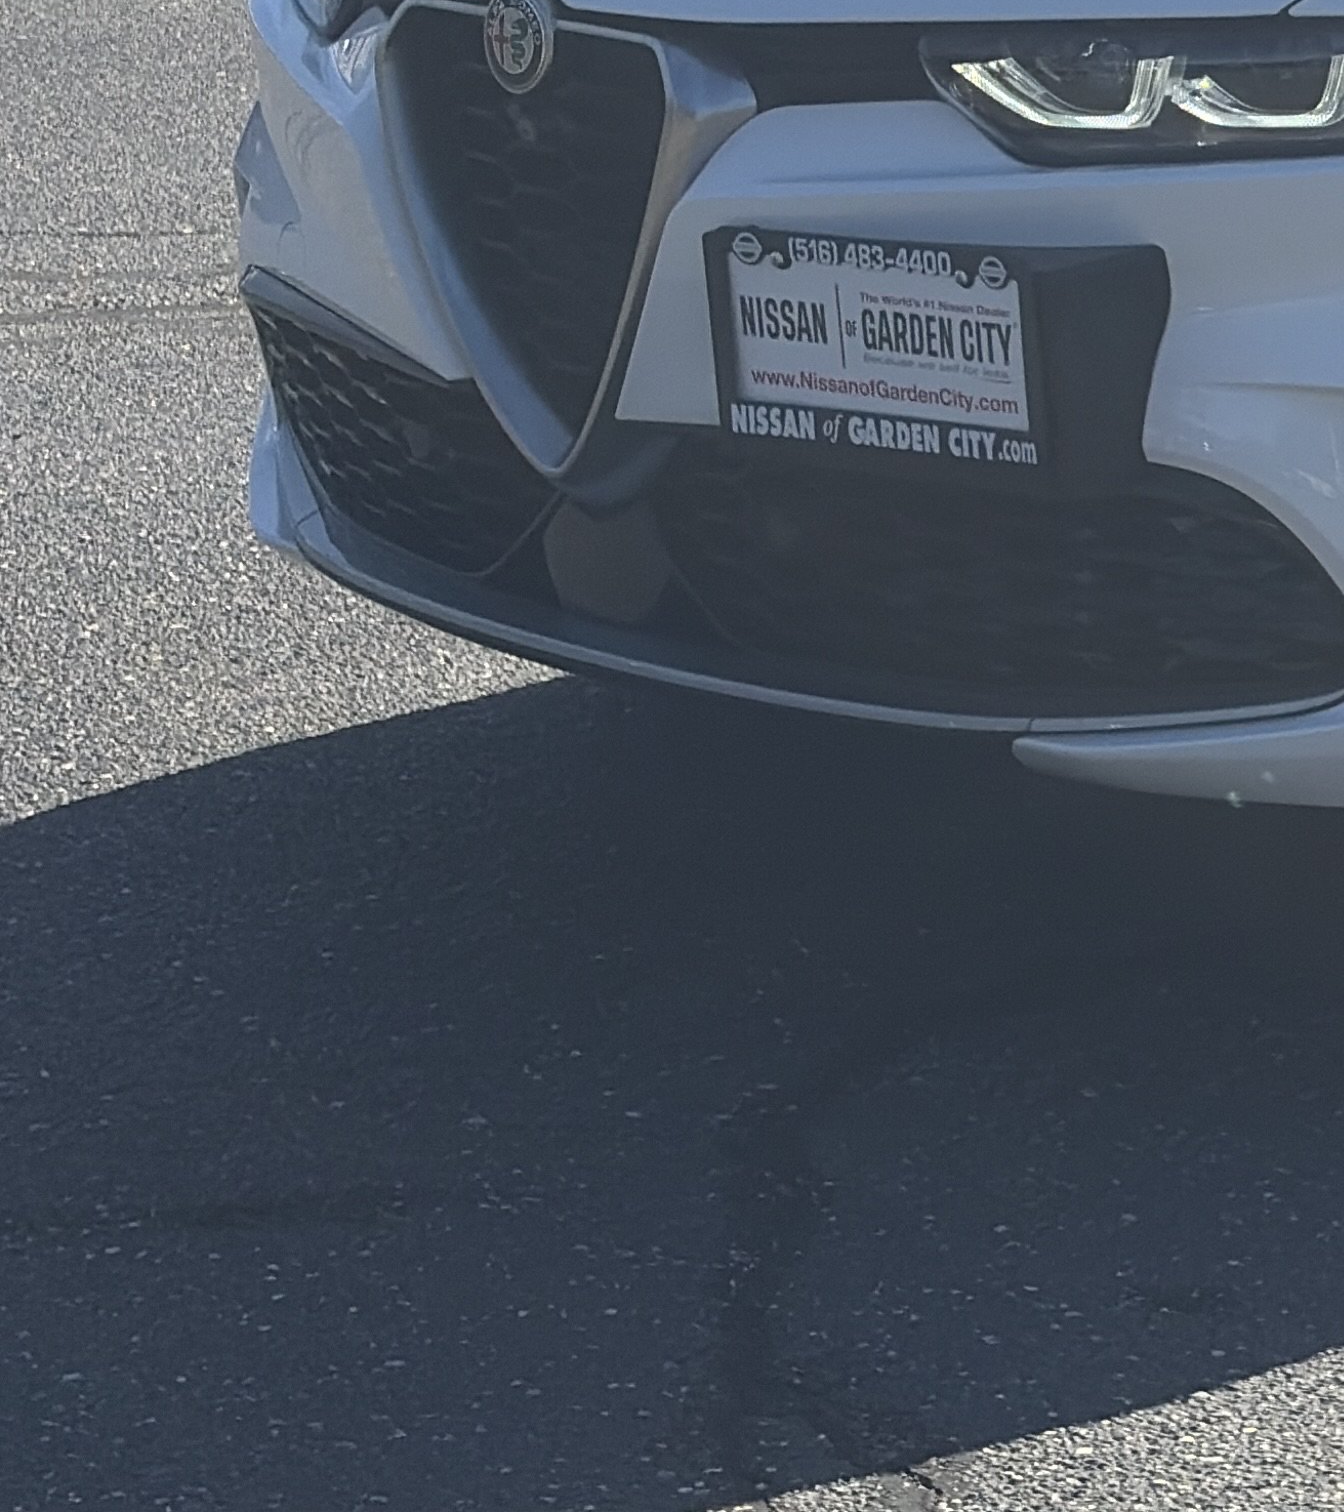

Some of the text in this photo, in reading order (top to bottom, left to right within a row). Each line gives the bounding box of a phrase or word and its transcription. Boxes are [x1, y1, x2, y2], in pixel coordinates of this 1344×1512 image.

[788, 236, 952, 276] (516) 483-4400
[860, 291, 879, 304] The
[881, 295, 921, 308] World's
[938, 300, 974, 314] Nissan
[739, 294, 829, 345] NISSAN
[861, 308, 955, 360] GARDEN
[959, 318, 1012, 366] CITY
[751, 369, 1019, 414] www.NissanofGardenCity.com
[730, 403, 1038, 465] NISSAN of GARDEN CITY.com
